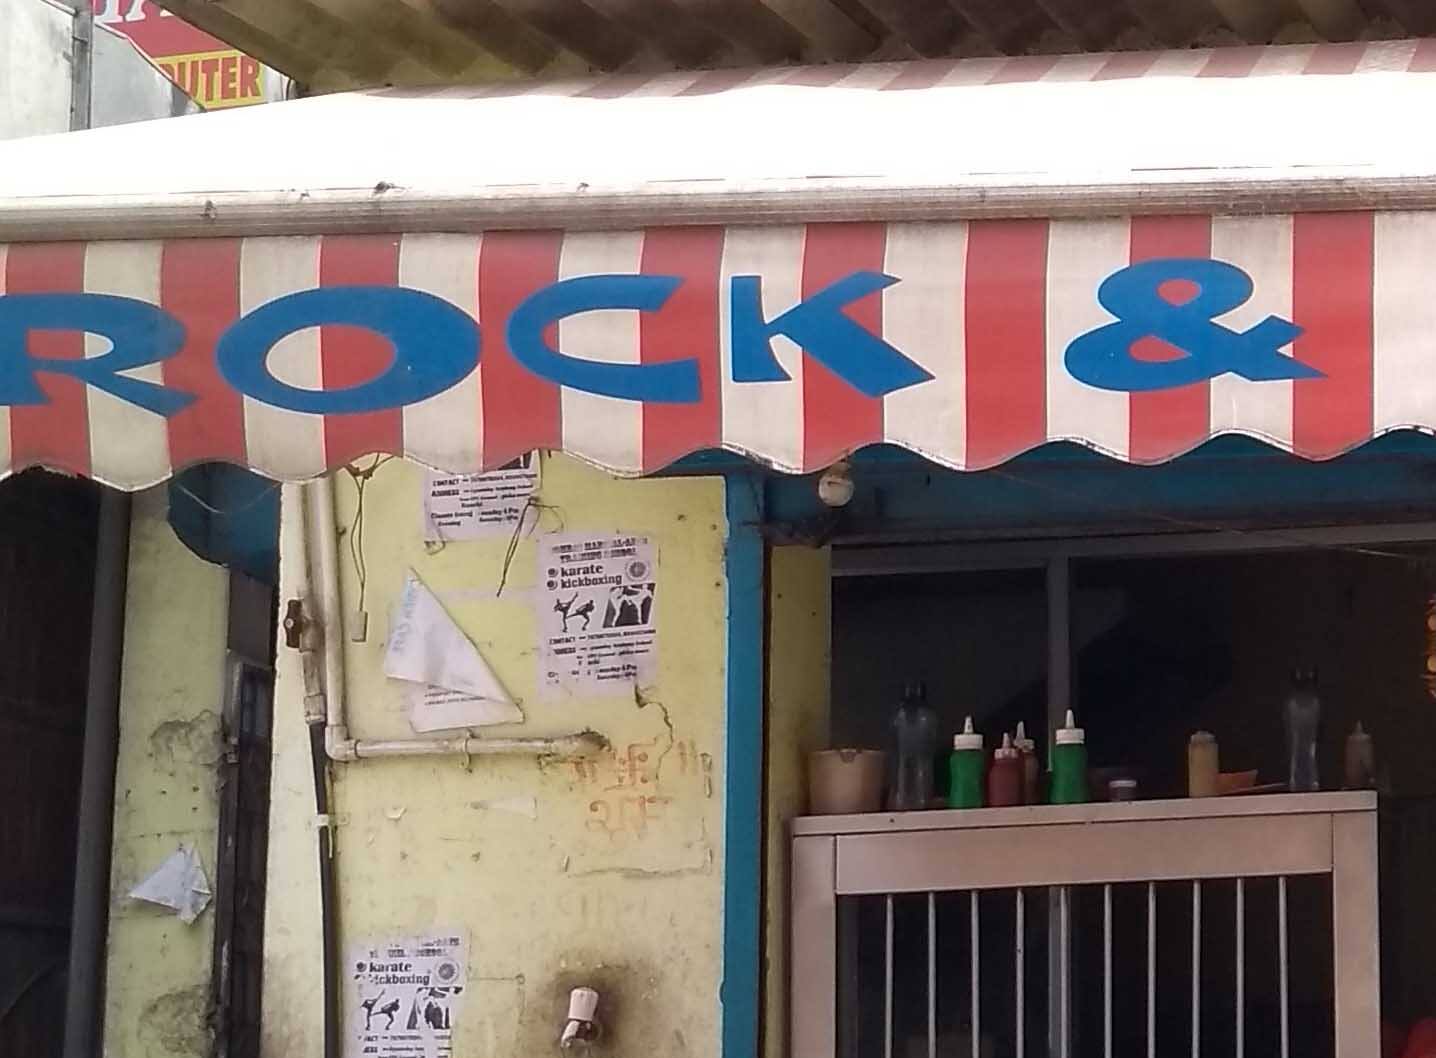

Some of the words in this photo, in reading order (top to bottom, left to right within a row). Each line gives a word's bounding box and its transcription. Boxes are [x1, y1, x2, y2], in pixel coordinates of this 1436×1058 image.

[0, 270, 936, 418] ROCK
[1064, 258, 1327, 391] &
[561, 564, 604, 577] karate
[560, 575, 623, 589] kickboxing
[369, 962, 413, 973] karate
